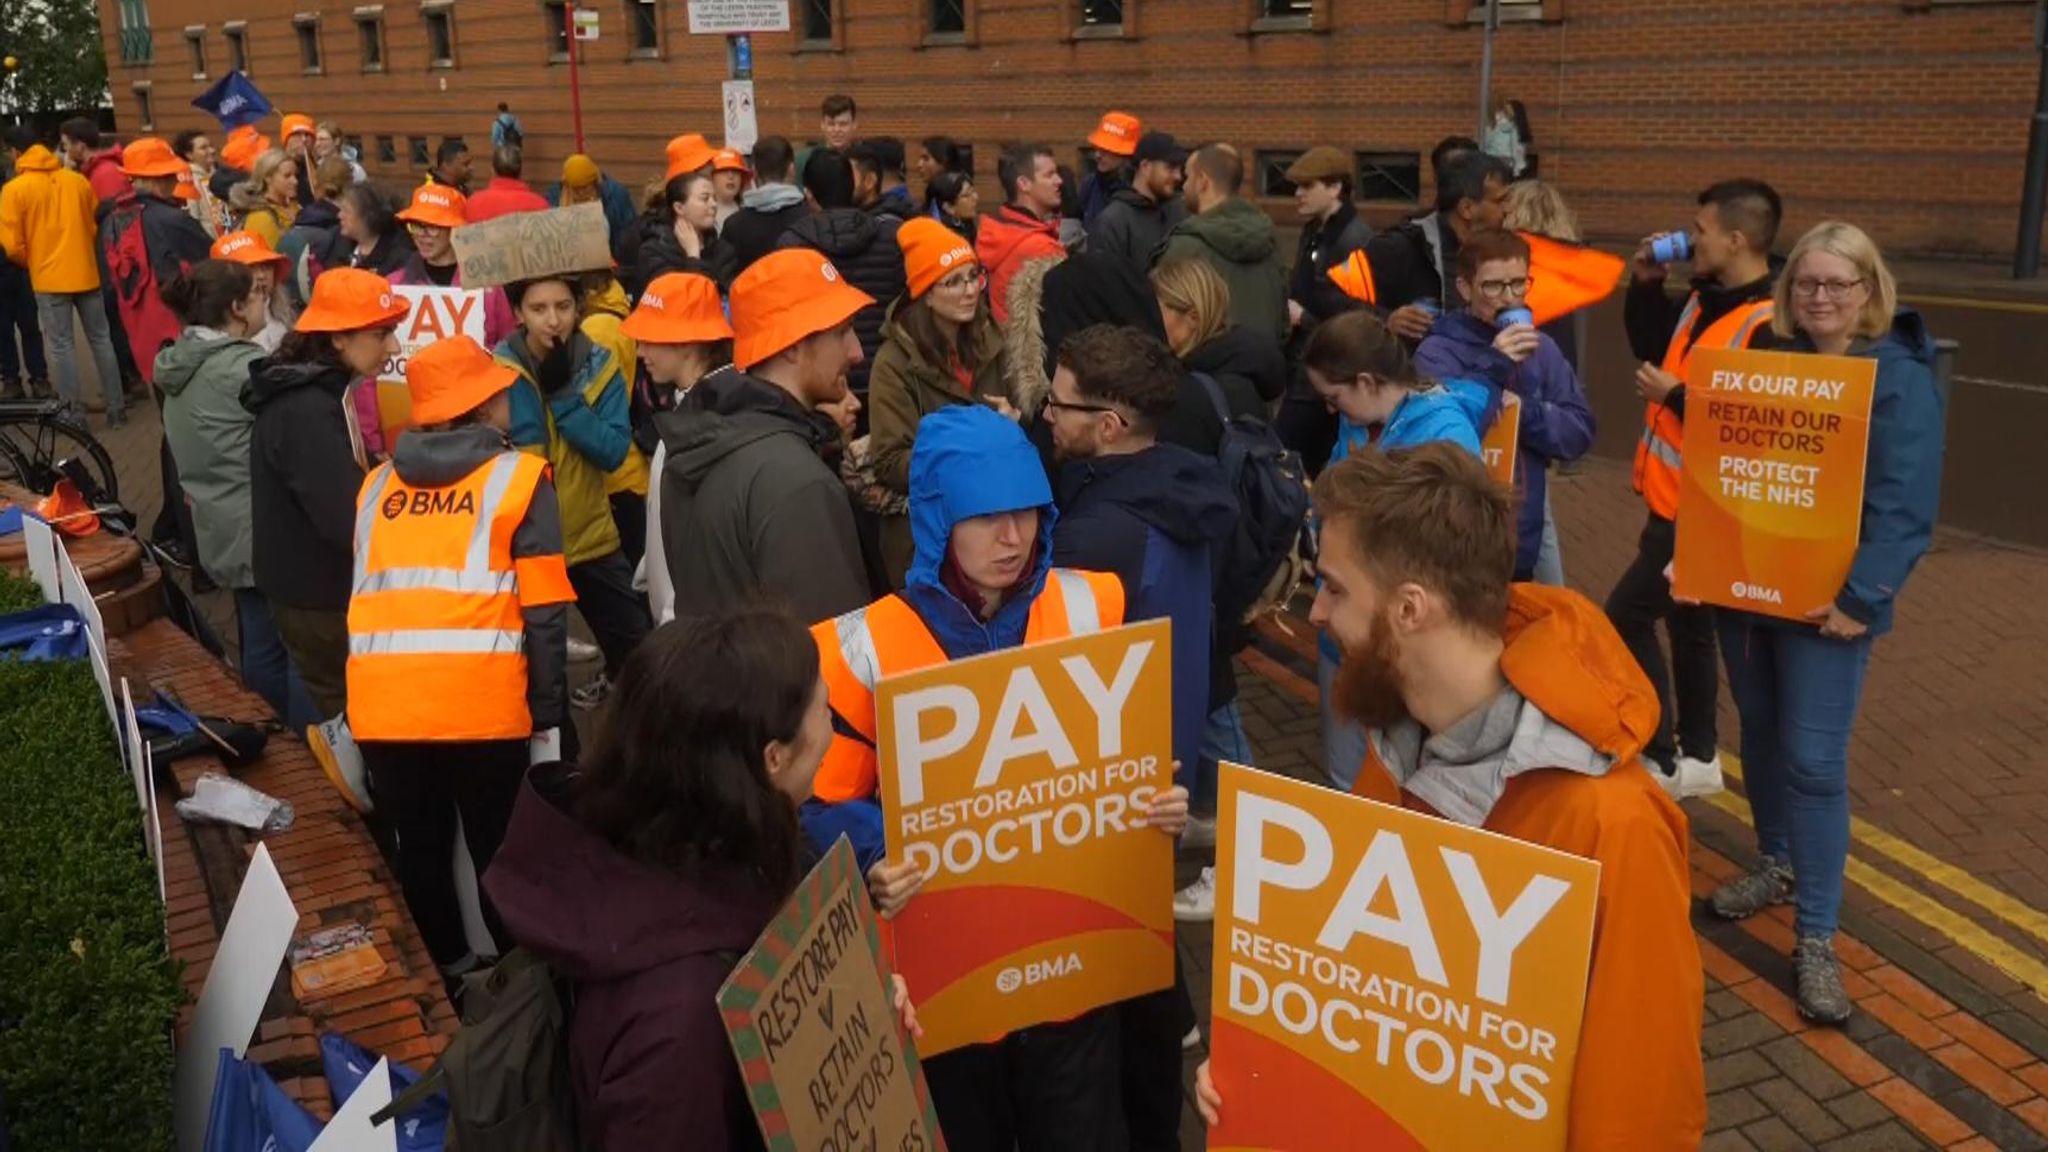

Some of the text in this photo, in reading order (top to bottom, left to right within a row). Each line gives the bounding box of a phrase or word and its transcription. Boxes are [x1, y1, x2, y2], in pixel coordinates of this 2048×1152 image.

[395, 293, 477, 341] AY
[1711, 371, 1846, 400] FIX OUR PAY
[1708, 401, 1842, 433] RETAIN OUR
[1719, 425, 1825, 455] DOCTORS
[1719, 456, 1820, 486] PROTECT
[1719, 477, 1816, 508] THE NHS
[409, 490, 475, 516] BMA
[1747, 584, 1783, 604] BMA
[892, 639, 1156, 807] PAY
[900, 755, 1158, 839] RESTORATION FOR
[903, 785, 1159, 883] DOCTORS
[1232, 790, 1572, 1007] PAY
[757, 887, 859, 1064] RESTORE PAY
[1024, 952, 1084, 986] BMA
[1231, 926, 1557, 1063] RESTORATION FOR
[808, 1001, 872, 1124] RETAIN
[1228, 961, 1551, 1121] DOCTORS
